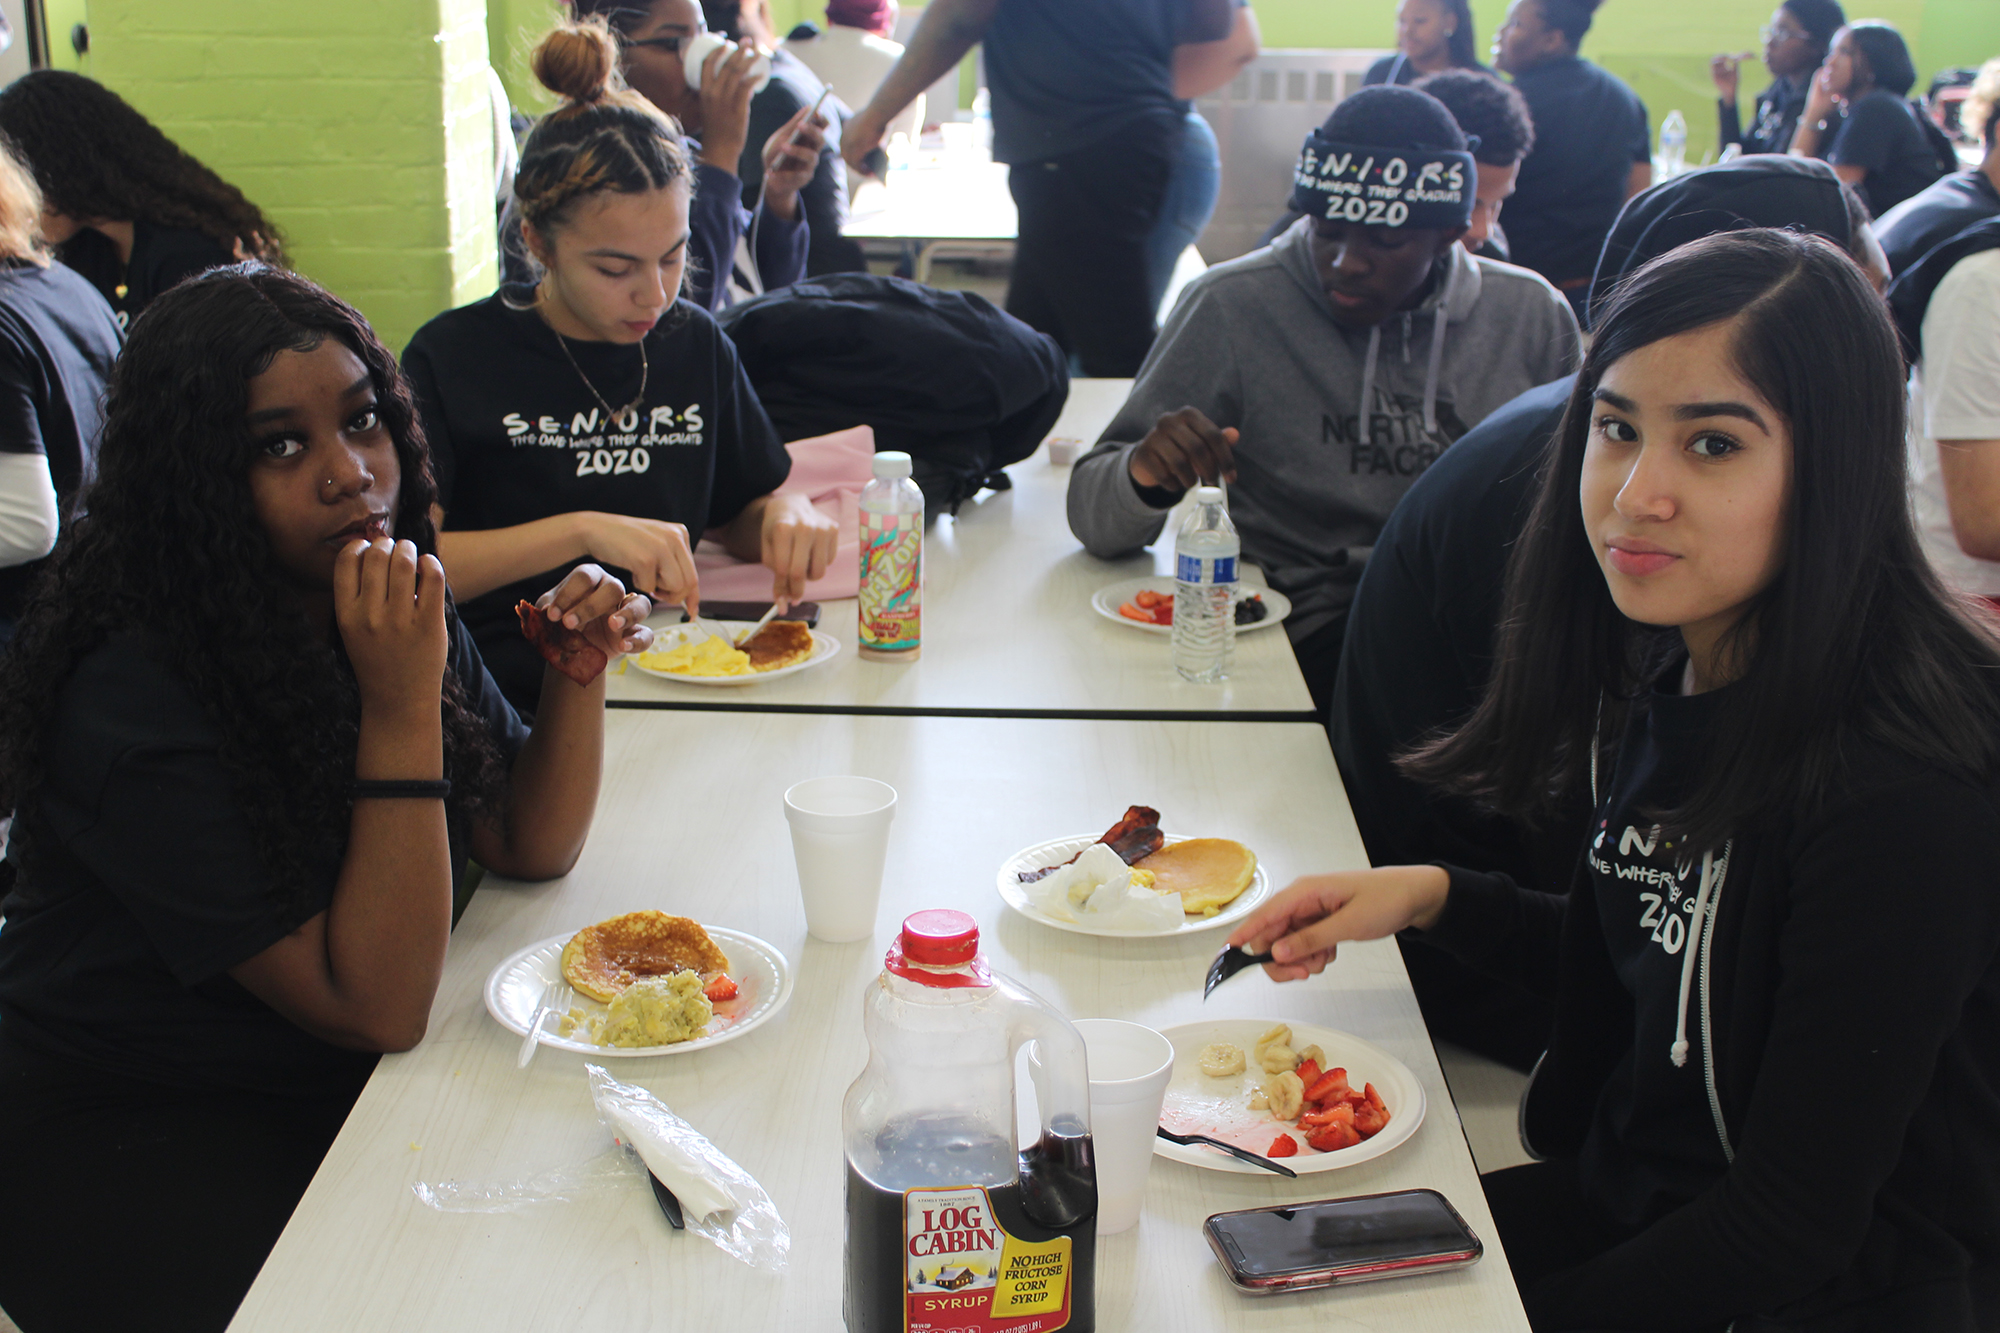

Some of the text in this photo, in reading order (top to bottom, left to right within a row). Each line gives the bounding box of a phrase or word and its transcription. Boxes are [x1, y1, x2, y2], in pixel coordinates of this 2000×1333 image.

[1368, 184, 1402, 199] THEY
[1325, 195, 1409, 227] 2020
[510, 433, 538, 447] THE
[538, 433, 567, 448] ONE
[608, 433, 638, 446] THEY
[640, 432, 703, 446] GRADUATE
[576, 447, 651, 477] 2020
[1614, 862, 1675, 889] WHER
[922, 1206, 982, 1233] LOG
[909, 1228, 997, 1257] CABIN
[1010, 1252, 1062, 1269] NO HIGH
[1004, 1264, 1063, 1280] FRUCTOSE
[1014, 1280, 1047, 1292] CORN
[925, 1295, 988, 1311] SYRUP
[1010, 1291, 1048, 1305] SYRUP
